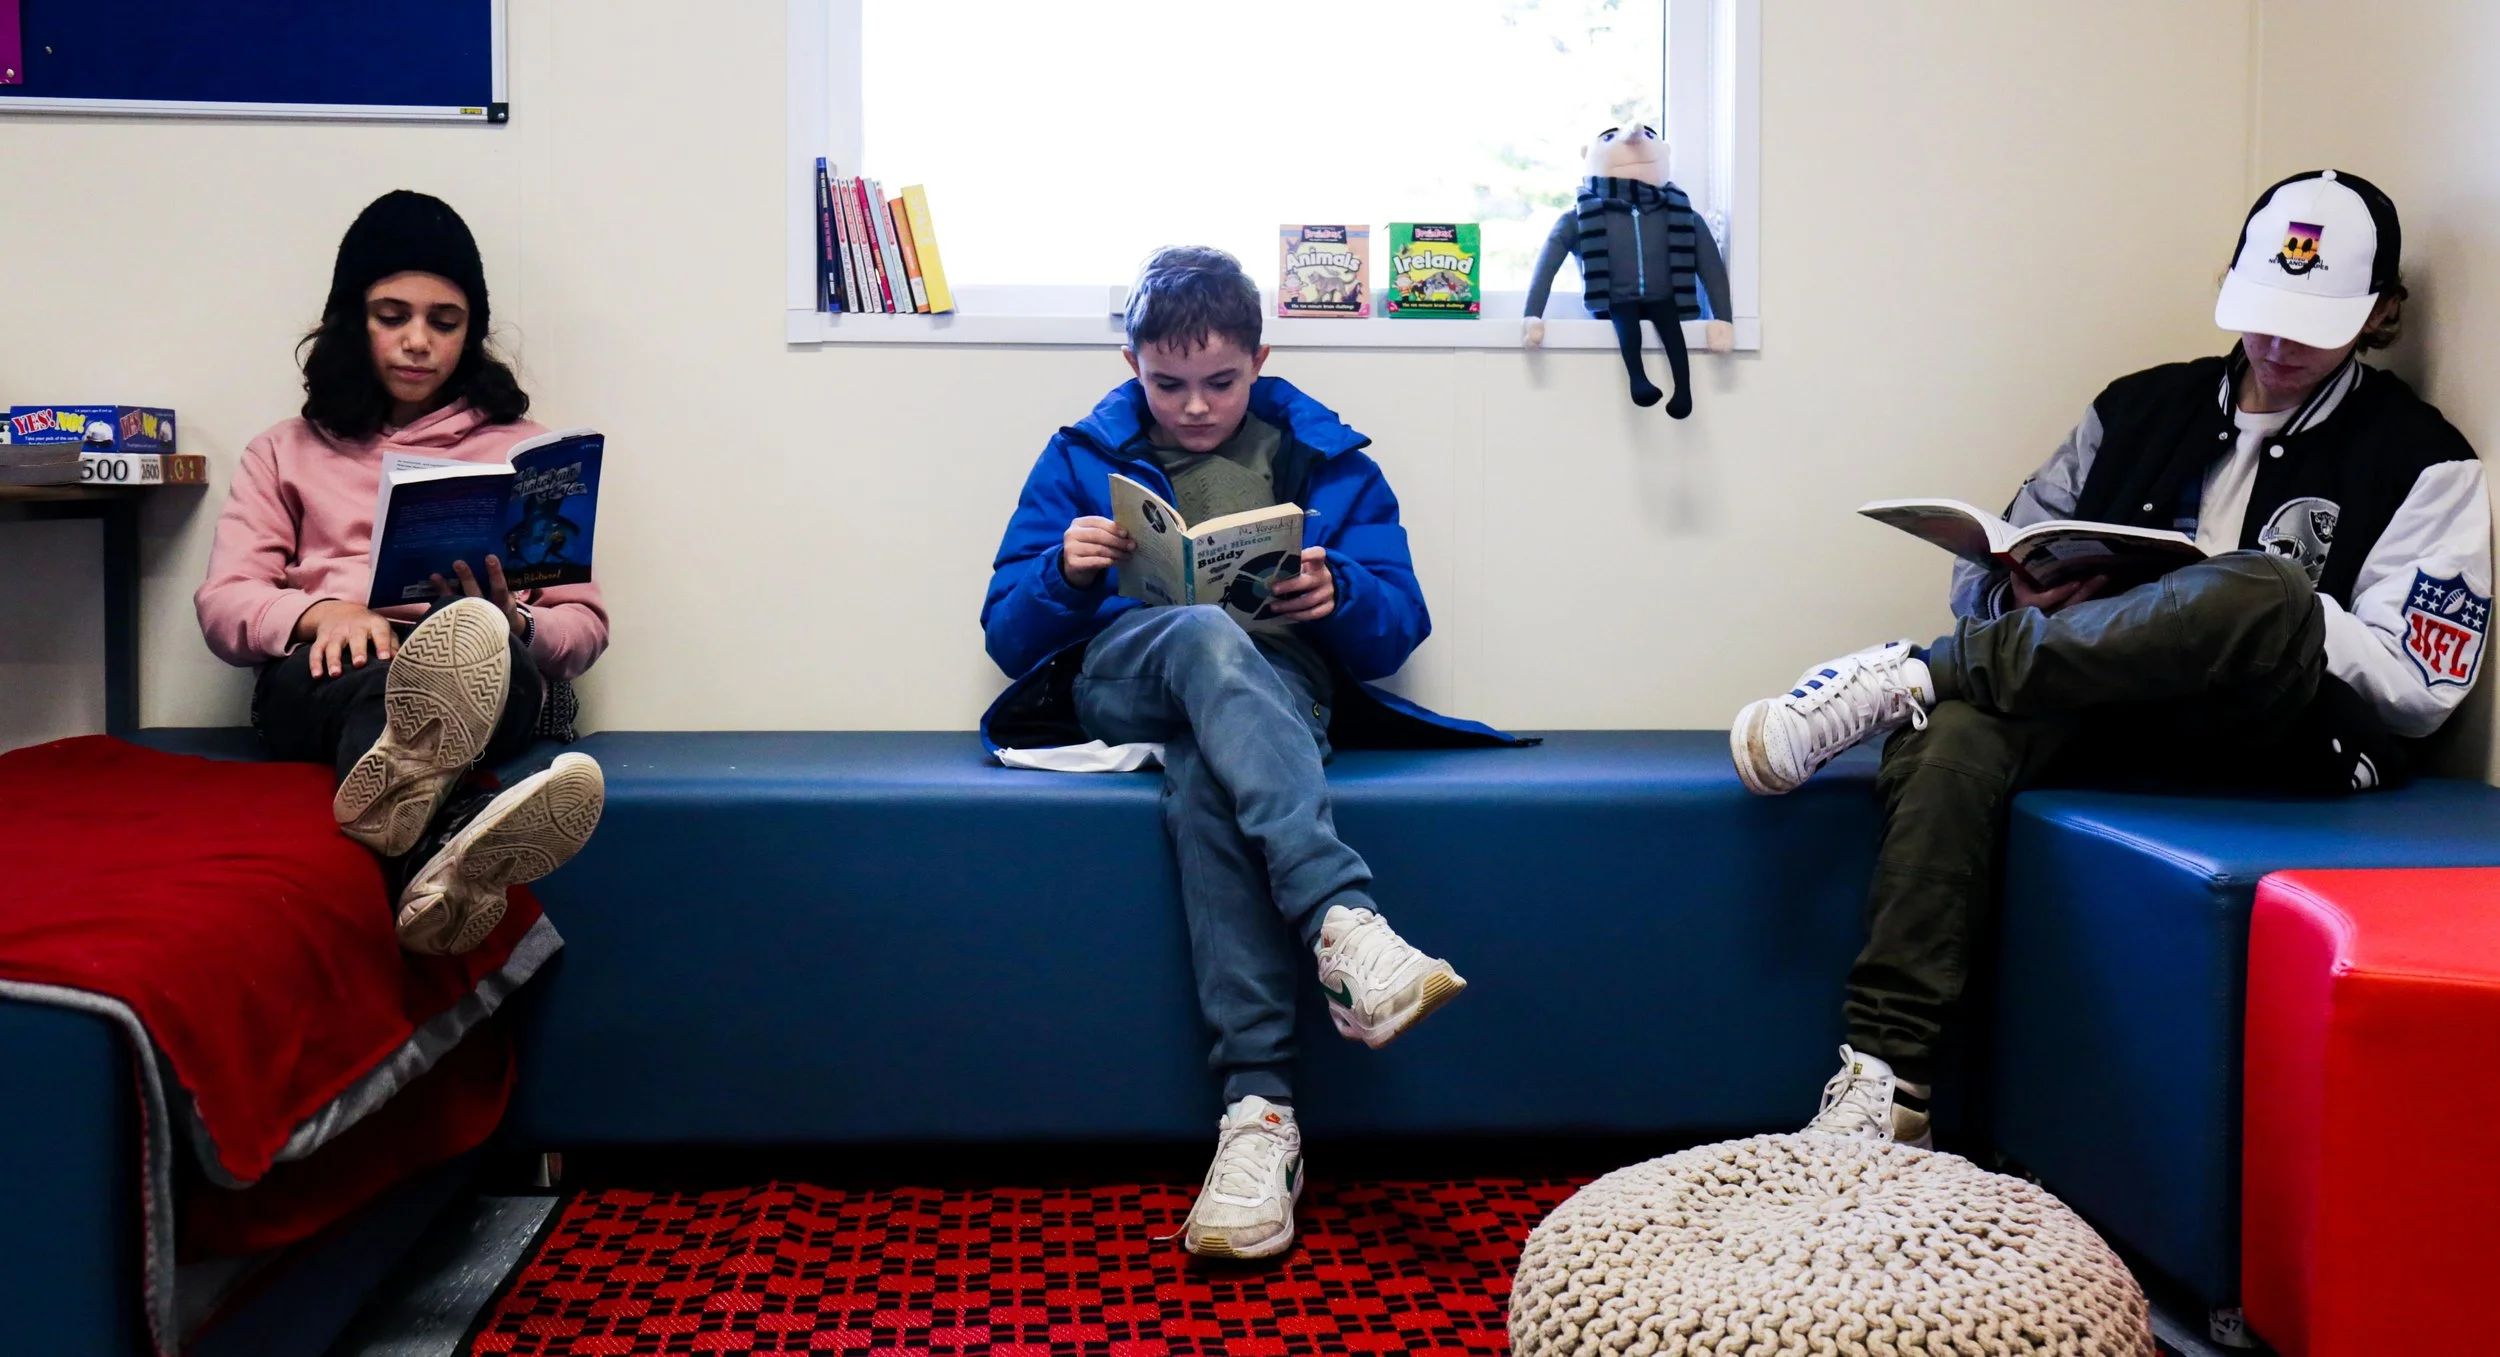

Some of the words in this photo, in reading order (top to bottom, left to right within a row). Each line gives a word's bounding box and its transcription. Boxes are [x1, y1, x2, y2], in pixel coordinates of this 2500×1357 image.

[1286, 246, 1361, 272] Animals
[1393, 250, 1475, 274] Ireland
[11, 408, 56, 436] YES!
[54, 411, 86, 434] NO!
[1197, 543, 1227, 559] Nigel
[1230, 536, 1272, 549] Hinton
[1197, 550, 1245, 569] Buddy
[2410, 613, 2472, 679] NFL
